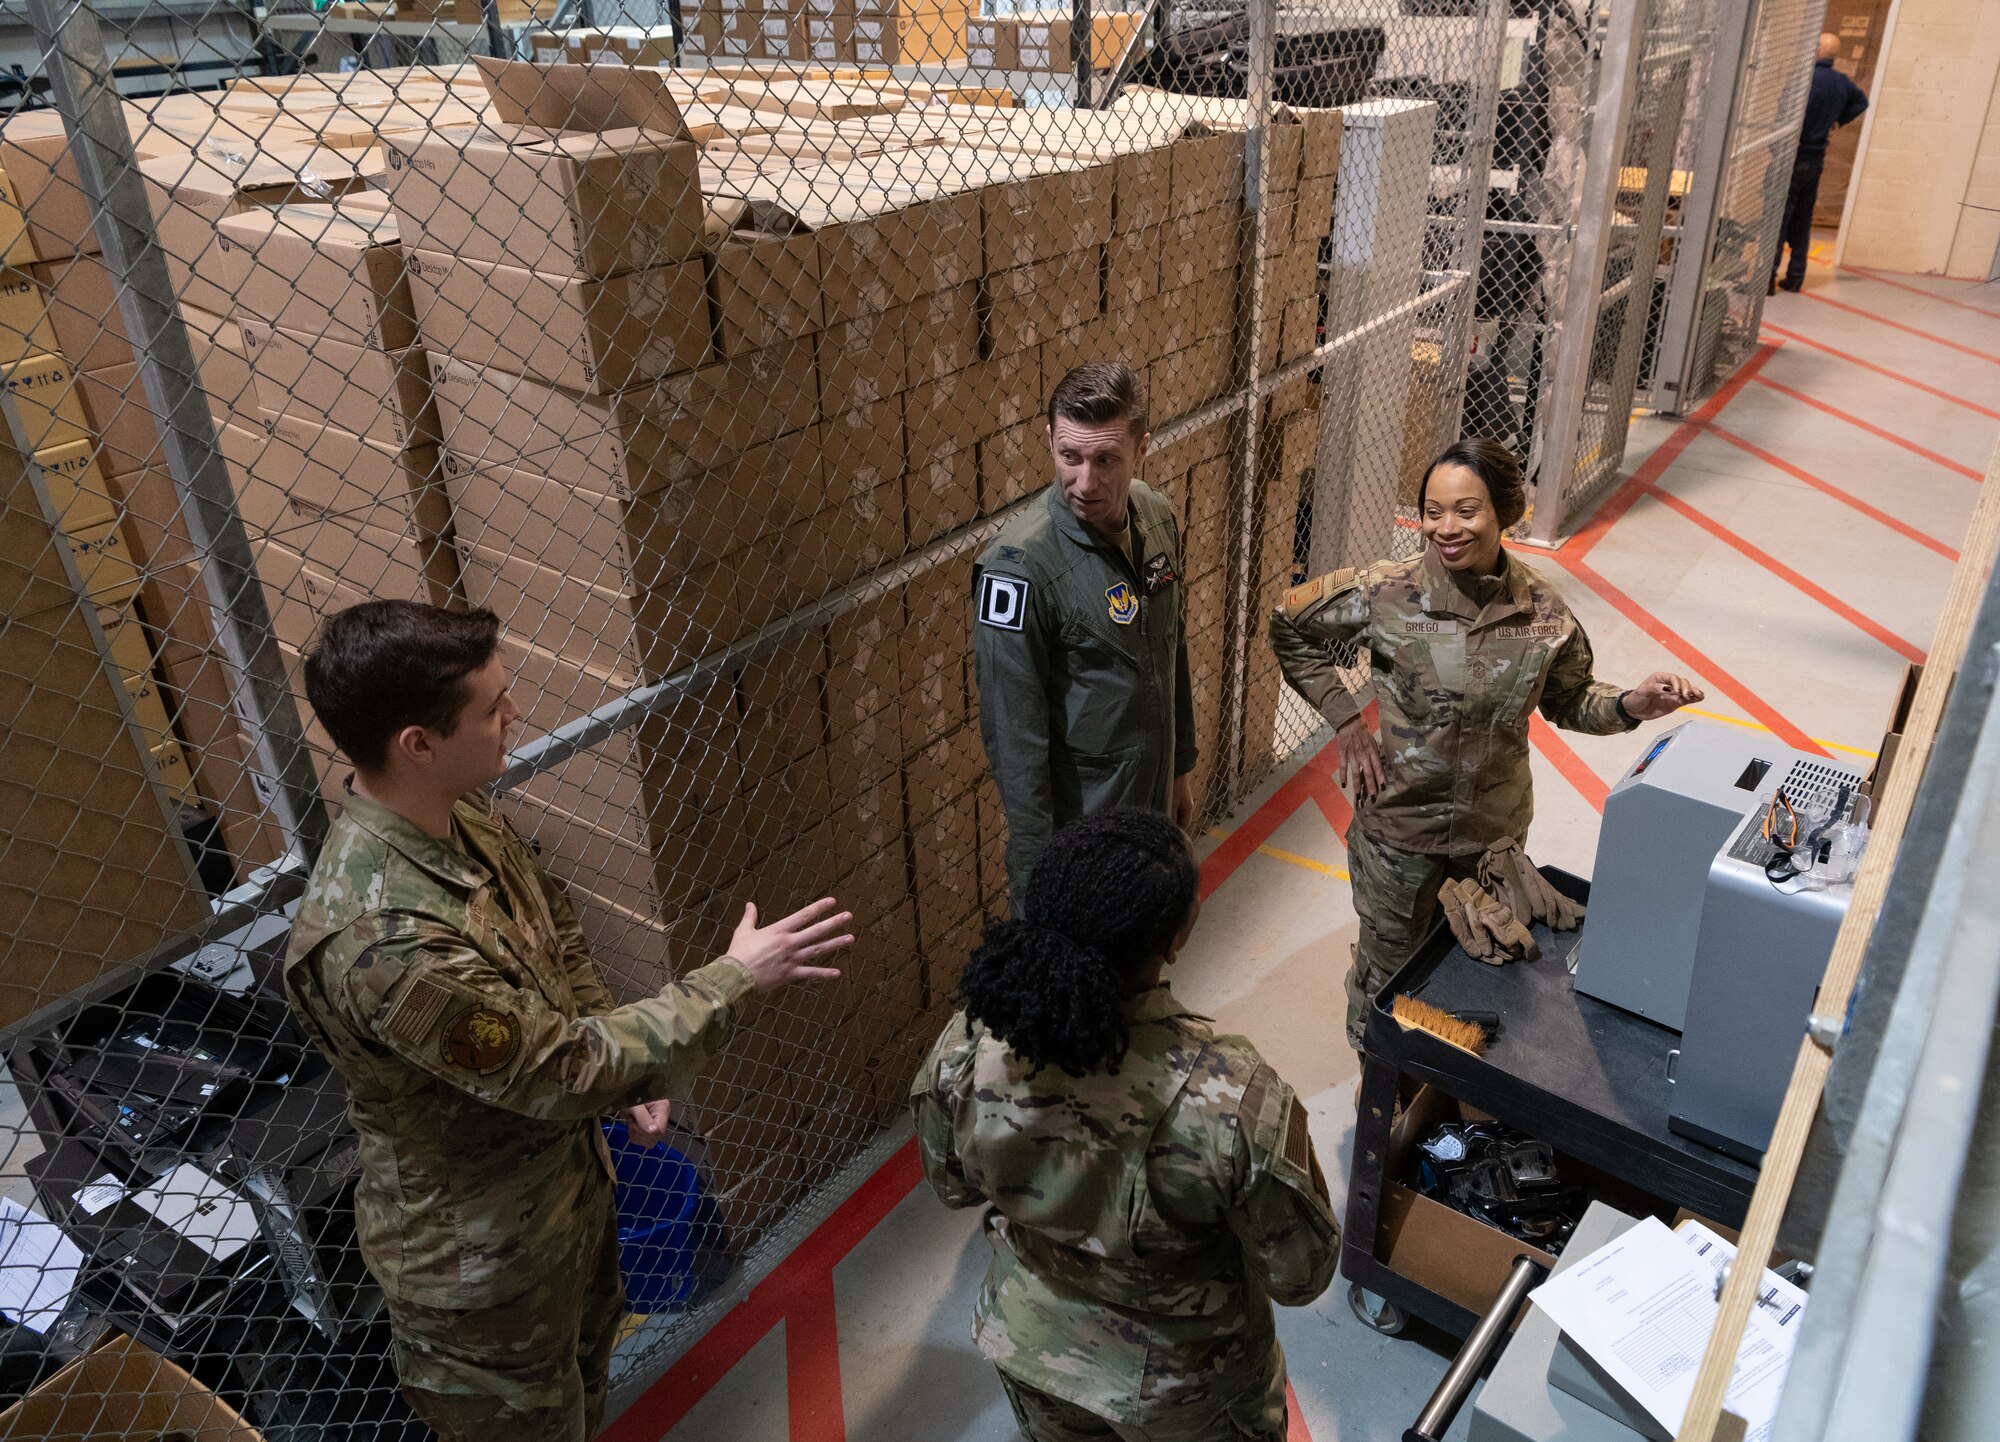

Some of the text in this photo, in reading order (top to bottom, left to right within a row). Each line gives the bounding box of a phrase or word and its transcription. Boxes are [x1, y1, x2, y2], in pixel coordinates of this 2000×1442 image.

[408, 254, 421, 275] hp
[421, 261, 442, 276] Desktop
[447, 371, 469, 387] Desktop
[583, 366, 594, 379] 16
[445, 455, 458, 475] hp
[988, 579, 1018, 624] D
[1405, 621, 1439, 633] GRIEGO
[1498, 624, 1559, 638] U.S. AIR FORCE
